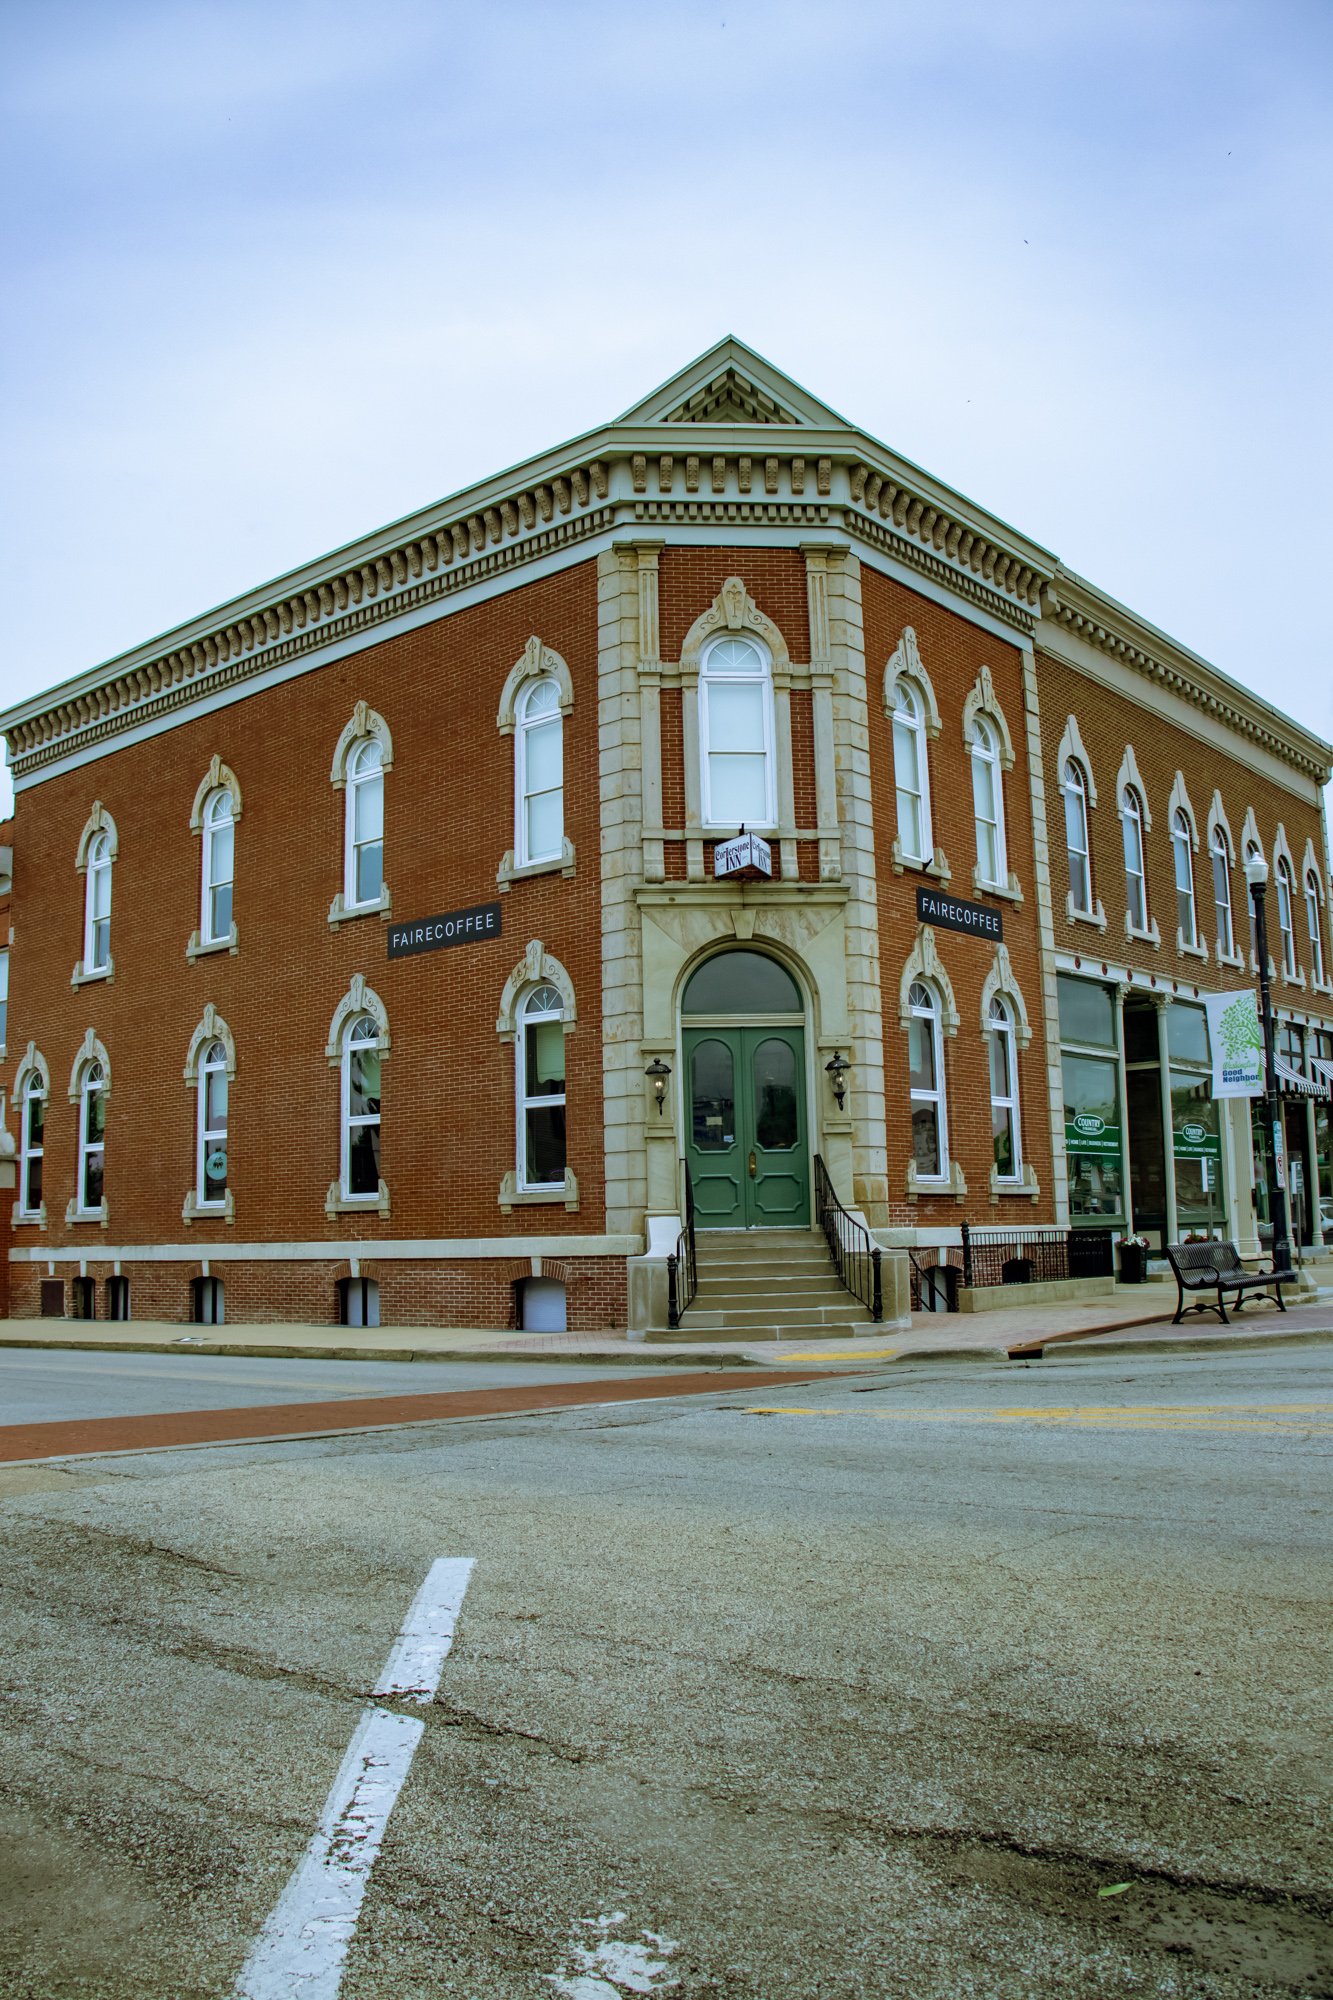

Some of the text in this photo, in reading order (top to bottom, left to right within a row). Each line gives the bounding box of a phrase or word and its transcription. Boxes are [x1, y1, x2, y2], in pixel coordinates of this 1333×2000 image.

[922, 897, 999, 932] FAIRECOFFEE
[393, 913, 494, 948] FAIRECOFFEE
[1222, 1074, 1259, 1083] Neighbor
[1077, 1117, 1100, 1127] COUNTRY
